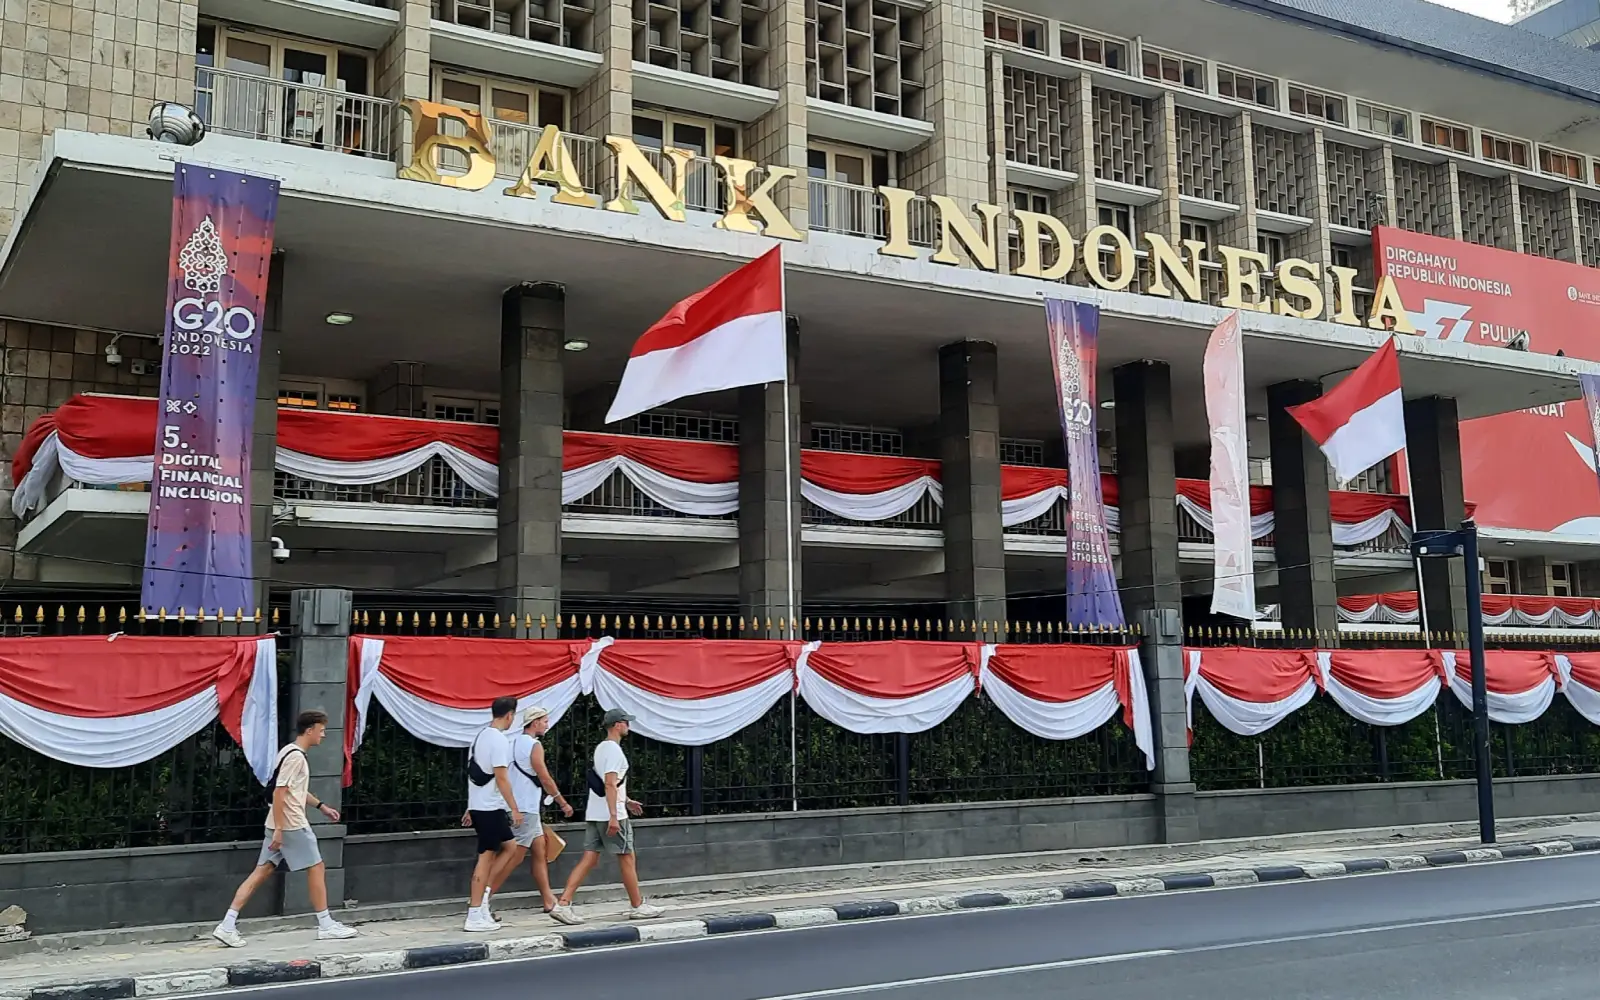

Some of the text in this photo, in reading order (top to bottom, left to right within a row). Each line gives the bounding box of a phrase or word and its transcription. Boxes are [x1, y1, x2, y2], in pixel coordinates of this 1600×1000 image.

[397, 99, 1418, 335] BANK INDONESIA
[1385, 246, 1457, 272] DIRGAHAYU
[1387, 262, 1513, 297] REPUBLIK INDONESIA
[173, 297, 256, 340] G20
[170, 344, 211, 356] 2022
[171, 331, 253, 354] INDONESIA
[1063, 396, 1092, 426] G20
[163, 424, 188, 448] 5.
[161, 453, 223, 470] DIGITAL
[161, 469, 243, 489] FINANCIAL
[160, 486, 243, 505] INCLUSION
